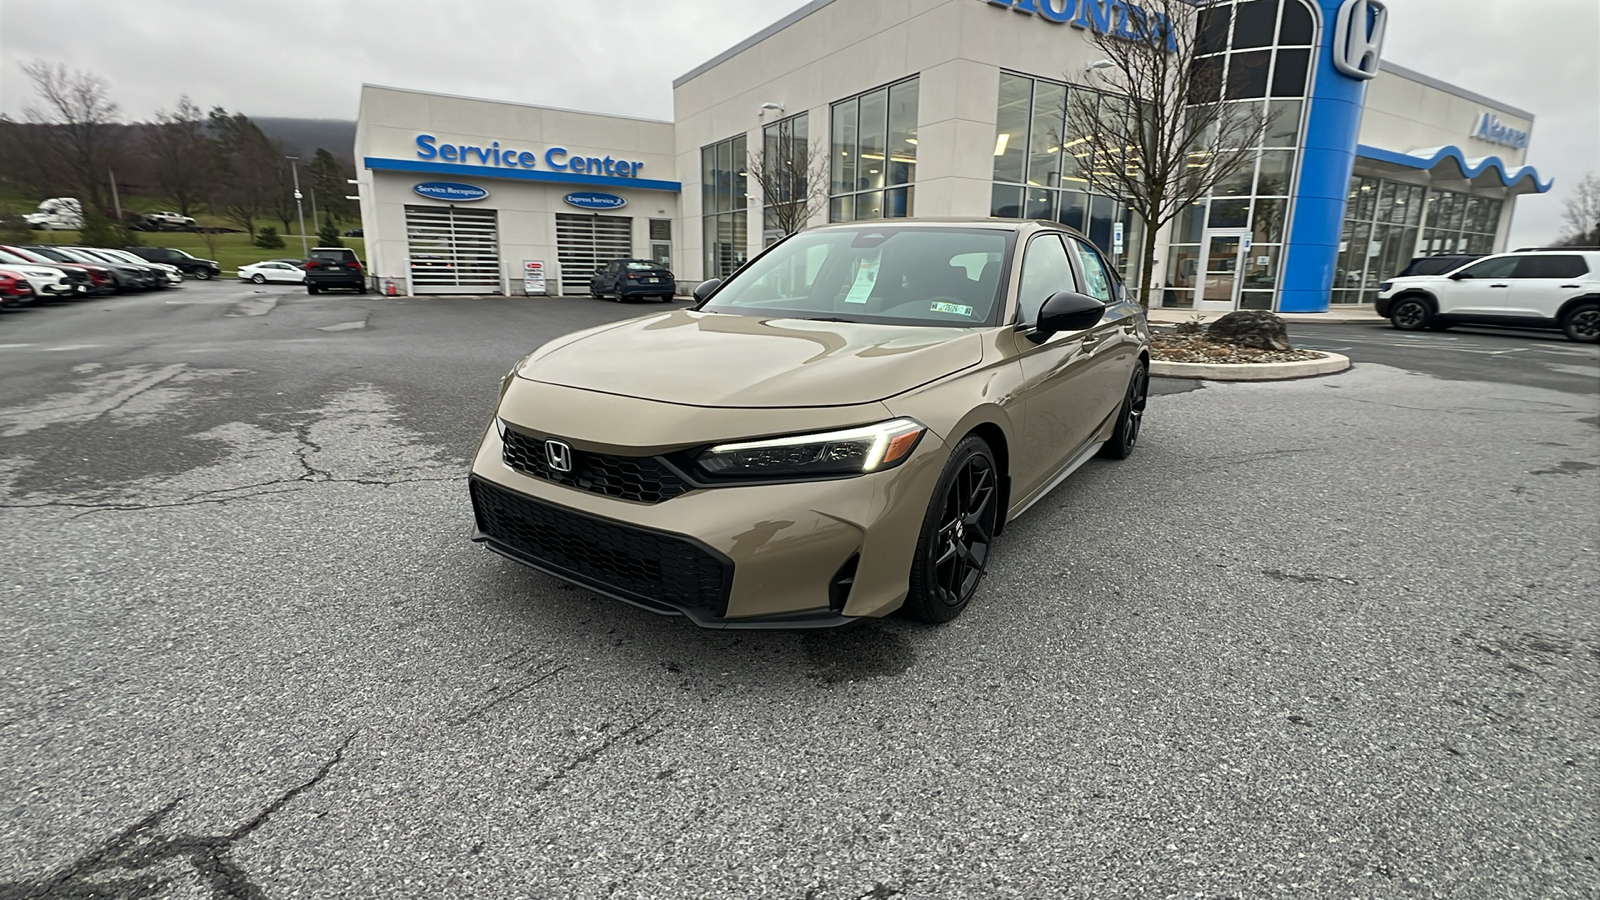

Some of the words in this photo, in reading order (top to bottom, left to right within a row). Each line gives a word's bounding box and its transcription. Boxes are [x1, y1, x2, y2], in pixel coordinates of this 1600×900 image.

[415, 134, 536, 169] Service
[545, 147, 643, 177] Center
[417, 185, 446, 194] Service
[447, 187, 484, 197] Reception
[567, 195, 591, 203] Express
